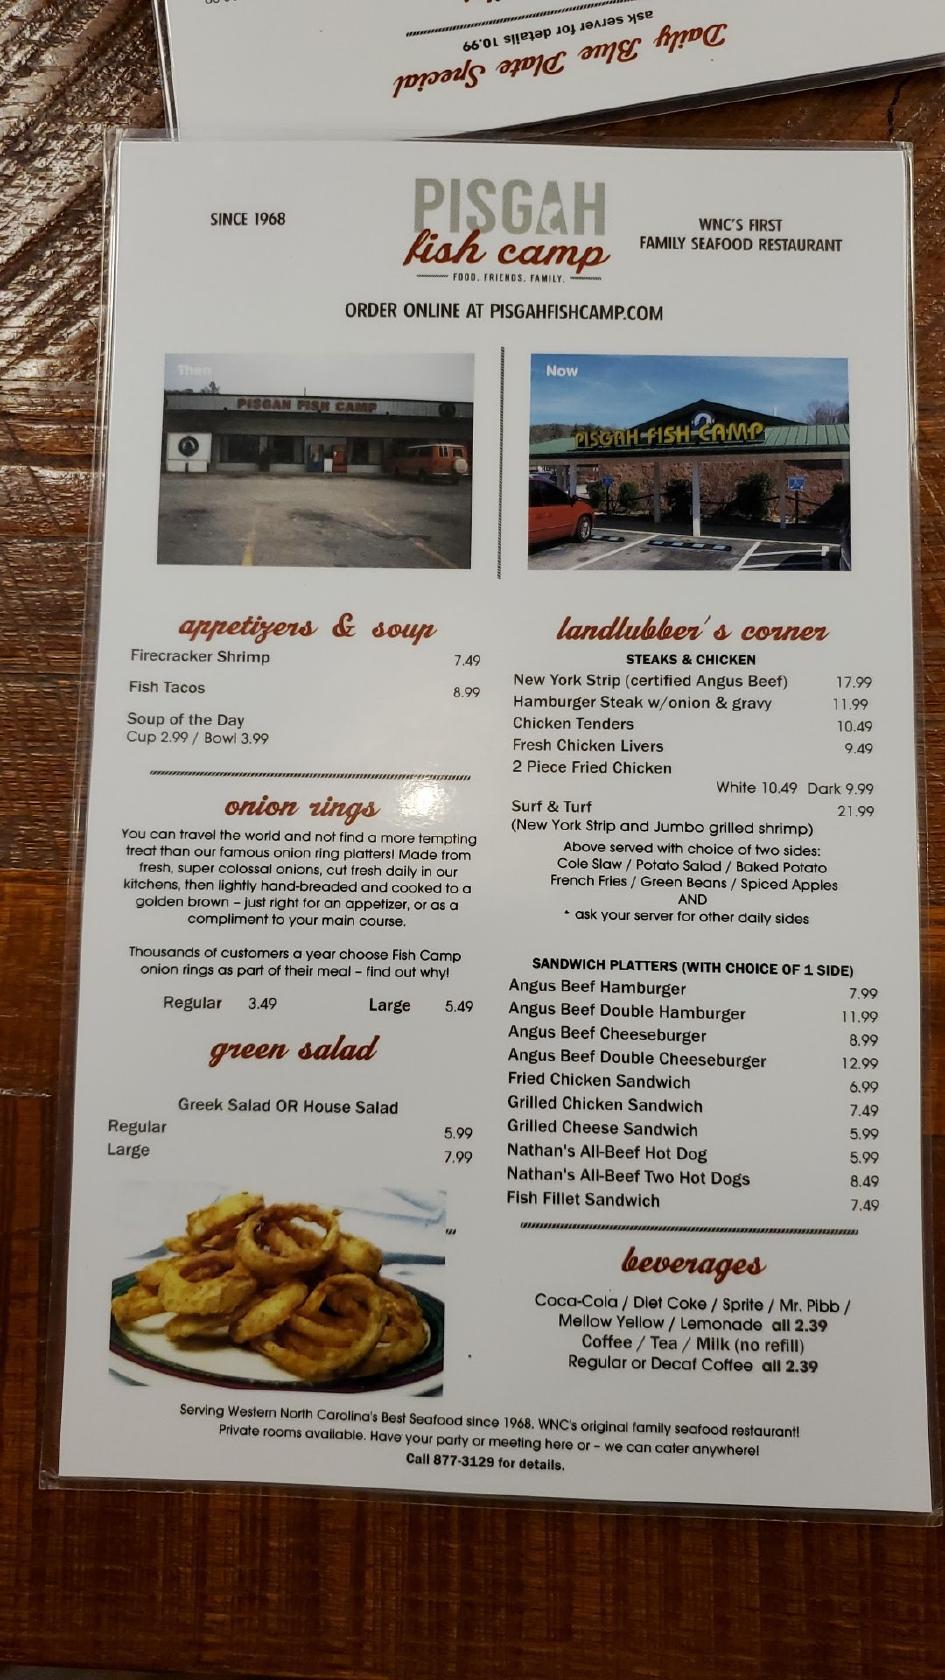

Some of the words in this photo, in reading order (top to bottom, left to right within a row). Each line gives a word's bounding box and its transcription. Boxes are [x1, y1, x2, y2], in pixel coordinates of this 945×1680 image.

[580, 17, 624, 32] server
[629, 10, 654, 24] ask
[503, 27, 552, 45] details
[556, 22, 577, 36] for
[463, 37, 500, 52] 10.99
[654, 23, 728, 53] Daily
[577, 37, 642, 64] Blue
[496, 50, 567, 77] Plate
[392, 59, 486, 98] Special
[414, 178, 605, 236] PISGAH
[210, 212, 248, 226] SINCE
[255, 212, 286, 226] 1968
[698, 218, 744, 232] WNC'S
[749, 218, 783, 232] FIRST
[403, 228, 486, 266] fish
[497, 243, 611, 274] camp
[640, 236, 686, 250] FAMILY
[691, 236, 753, 251] SEAFOOD
[759, 238, 843, 252] RESTAURANT
[345, 302, 397, 318] ORDER
[403, 302, 460, 318] ONLINE
[466, 303, 484, 319] AT
[490, 303, 663, 321] PISGAHFISHCAMP.COM
[546, 365, 578, 377] Now
[335, 402, 377, 413] CAMP
[575, 428, 639, 448] PISGAH
[648, 424, 691, 444] FISH
[699, 421, 765, 442] CAMP
[178, 615, 318, 644] appetizers
[331, 612, 356, 638] &
[371, 621, 438, 646] soup
[740, 625, 830, 641] corner
[131, 648, 213, 662] Firecracker
[217, 650, 270, 666] Shrimp
[454, 654, 480, 666] 7.49
[626, 654, 678, 665] STEAKS
[682, 654, 692, 665] &
[696, 654, 756, 666] CHICKEN
[129, 680, 158, 692] Fish
[164, 681, 206, 694] Tacos
[514, 674, 546, 686] New
[550, 674, 582, 686] York
[586, 674, 620, 690] Strip
[626, 674, 691, 690] (certified
[696, 675, 743, 690] Angus
[748, 675, 788, 690] Beef)
[836, 676, 872, 688] 17.99
[453, 686, 480, 698] 8.99
[514, 696, 596, 711] Hamburger
[600, 696, 643, 708] Steak
[648, 696, 710, 711] w/onion
[715, 696, 728, 710] &
[732, 697, 772, 712] gravy
[833, 698, 868, 710] 11.99
[127, 712, 165, 727] Soup
[170, 713, 185, 725] of
[188, 714, 212, 726] the
[218, 714, 244, 730] Day
[513, 716, 571, 730] Chicken
[576, 717, 634, 730] Tenders
[837, 720, 872, 732] 10.49
[513, 738, 551, 751] Fresh
[556, 738, 615, 752] Chicken
[621, 739, 664, 752] Livers
[844, 742, 873, 754] 9.49
[512, 760, 522, 772] 2
[528, 760, 567, 774] Piece
[572, 760, 608, 774] Fried
[612, 761, 672, 774] Chicken
[716, 781, 757, 794] White
[762, 782, 798, 794] 10.49
[808, 782, 842, 795] Dark
[845, 782, 874, 795] 9.99
[224, 794, 300, 816] onion
[309, 796, 382, 826] rings
[512, 800, 543, 812] Surf
[547, 800, 559, 813] &
[563, 800, 592, 813] Turf
[837, 805, 874, 817] 21.99
[187, 913, 269, 926] compliment
[272, 913, 284, 925] to
[288, 916, 319, 928] your
[322, 914, 354, 926] main
[359, 918, 406, 927] course.
[129, 946, 200, 958] Thousands
[204, 947, 218, 958] of
[220, 948, 289, 959] customers
[292, 950, 302, 959] a
[306, 950, 336, 962] year
[339, 948, 388, 960] choose
[392, 948, 416, 961] Fish
[420, 949, 462, 964] Camp
[532, 957, 606, 970] SANDWICH
[610, 960, 678, 972] PLATTERS
[682, 962, 721, 975] (WITH
[725, 962, 778, 975] CHOICE
[782, 964, 801, 976] OF
[804, 964, 814, 976] 1
[816, 964, 854, 979] SIDE)
[508, 978, 556, 994] Angus
[561, 979, 596, 992] Beef
[600, 980, 686, 998] Hamburger
[849, 988, 878, 1000] 7.99
[164, 996, 222, 1012] Regular
[248, 997, 277, 1010] 3.49
[369, 998, 410, 1014] Large
[445, 1000, 474, 1012] 5.49
[208, 1042, 290, 1068] green
[297, 1034, 380, 1061] salad
[508, 1071, 544, 1085] Fried
[550, 1072, 611, 1087] Chicken
[616, 1074, 690, 1089] Sandwich
[850, 1080, 879, 1093] 6.99
[178, 1097, 223, 1111] Greek
[227, 1098, 270, 1112] Salad
[276, 1099, 298, 1112] OR
[304, 1100, 351, 1114] House
[355, 1100, 398, 1115] Salad
[108, 1119, 167, 1136] Regular
[444, 1126, 473, 1140] 5.99
[108, 1142, 150, 1159] Large
[444, 1150, 473, 1164] 7.99
[507, 1166, 575, 1181] Nathan's
[580, 1168, 640, 1183] All-Beef
[644, 1170, 674, 1184] Two
[680, 1171, 706, 1185] Hot
[711, 1172, 750, 1188] Dogs
[850, 1174, 880, 1188] 8.49
[507, 1190, 537, 1204] Fish
[543, 1191, 580, 1206] Fillet
[584, 1192, 660, 1208] Sandwich
[851, 1199, 880, 1212] 7.49
[621, 1246, 767, 1284] beverages
[568, 1354, 627, 1372] Regular
[631, 1359, 647, 1370] or
[651, 1356, 697, 1371] Decaf
[702, 1358, 753, 1372] Coffee
[762, 1360, 781, 1373] all
[786, 1360, 818, 1374] 2.39
[406, 1452, 430, 1465] Call
[433, 1454, 494, 1468] 877-3129
[498, 1457, 516, 1468] for
[519, 1458, 564, 1471] details.
